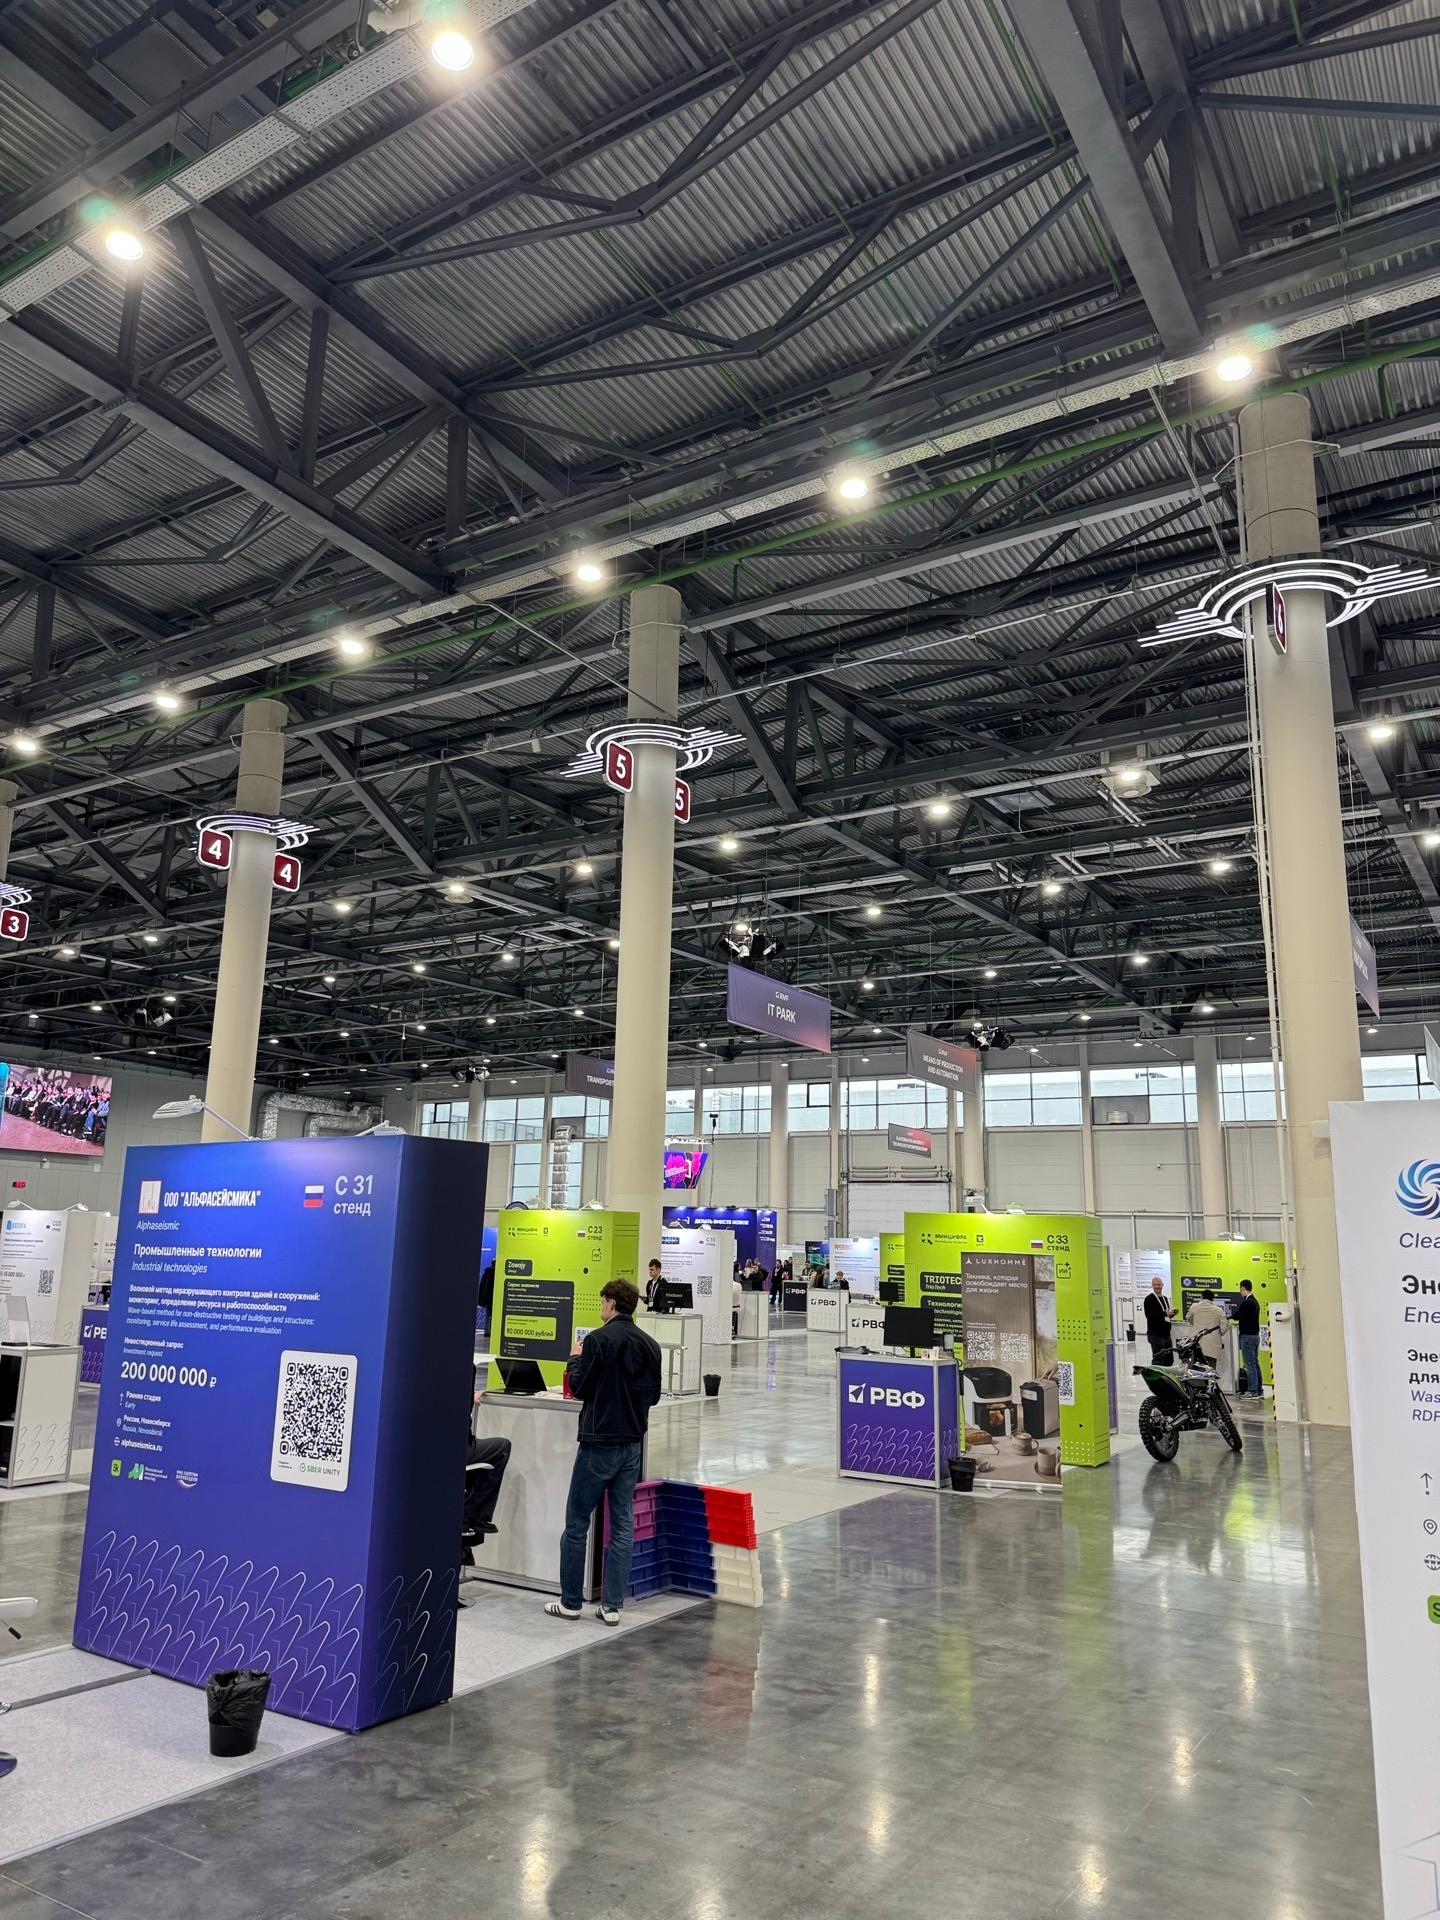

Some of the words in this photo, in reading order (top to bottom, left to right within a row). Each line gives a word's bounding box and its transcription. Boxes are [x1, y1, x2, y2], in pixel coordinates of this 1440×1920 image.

[1277, 603, 1283, 634] 6
[615, 754, 626, 779] 5
[675, 788, 684, 810] 5
[208, 839, 222, 860] 4
[280, 863, 292, 883] 4
[8, 916, 19, 933] 3
[768, 1003, 775, 1016] IT
[776, 1006, 796, 1023] PARK
[353, 1175, 373, 1195] 31
[180, 1189, 261, 1207] "АЛЬФАСЕЙСМИКА"
[334, 1202, 371, 1216] стенд
[136, 1220, 180, 1232] Alphaseismic
[133, 1243, 205, 1257] Промышленные
[207, 1246, 262, 1259] технологии
[132, 1261, 162, 1272] Industrial
[163, 1262, 207, 1275] technologies
[965, 1272, 991, 1281] Техника,
[1401, 1274, 1440, 1295] Эн
[129, 1284, 154, 1293] Волновой
[173, 1288, 222, 1297] неразрушающего
[222, 1290, 250, 1298] контроля
[251, 1290, 272, 1299] зданий
[278, 1292, 320, 1301] сооружений:
[160, 1298, 196, 1307] определение
[226, 1301, 287, 1311] работоспособности
[127, 1306, 155, 1315] Wave-based
[156, 1308, 174, 1316] method
[183, 1311, 221, 1319] non-destructive
[222, 1312, 240, 1322] testing
[241, 1313, 248, 1321] of
[248, 1314, 272, 1324] buildings
[178, 1322, 208, 1330] assessment,
[220, 1323, 253, 1332] performance
[253, 1326, 282, 1335] evaluation
[124, 1337, 165, 1347] Инвестиционный
[166, 1342, 184, 1350] запрос
[1407, 1349, 1440, 1362] Эне
[120, 1361, 146, 1380] 200
[149, 1363, 176, 1383] 000
[179, 1366, 207, 1387] 000
[1409, 1373, 1440, 1384] для
[125, 1401, 136, 1409] Early
[870, 1386, 926, 1409] РВФ
[141, 1417, 171, 1428] Новосибирск
[121, 1438, 163, 1452] alphaseismica.ru
[306, 1465, 322, 1474] SBER
[323, 1467, 341, 1477] UNITY
